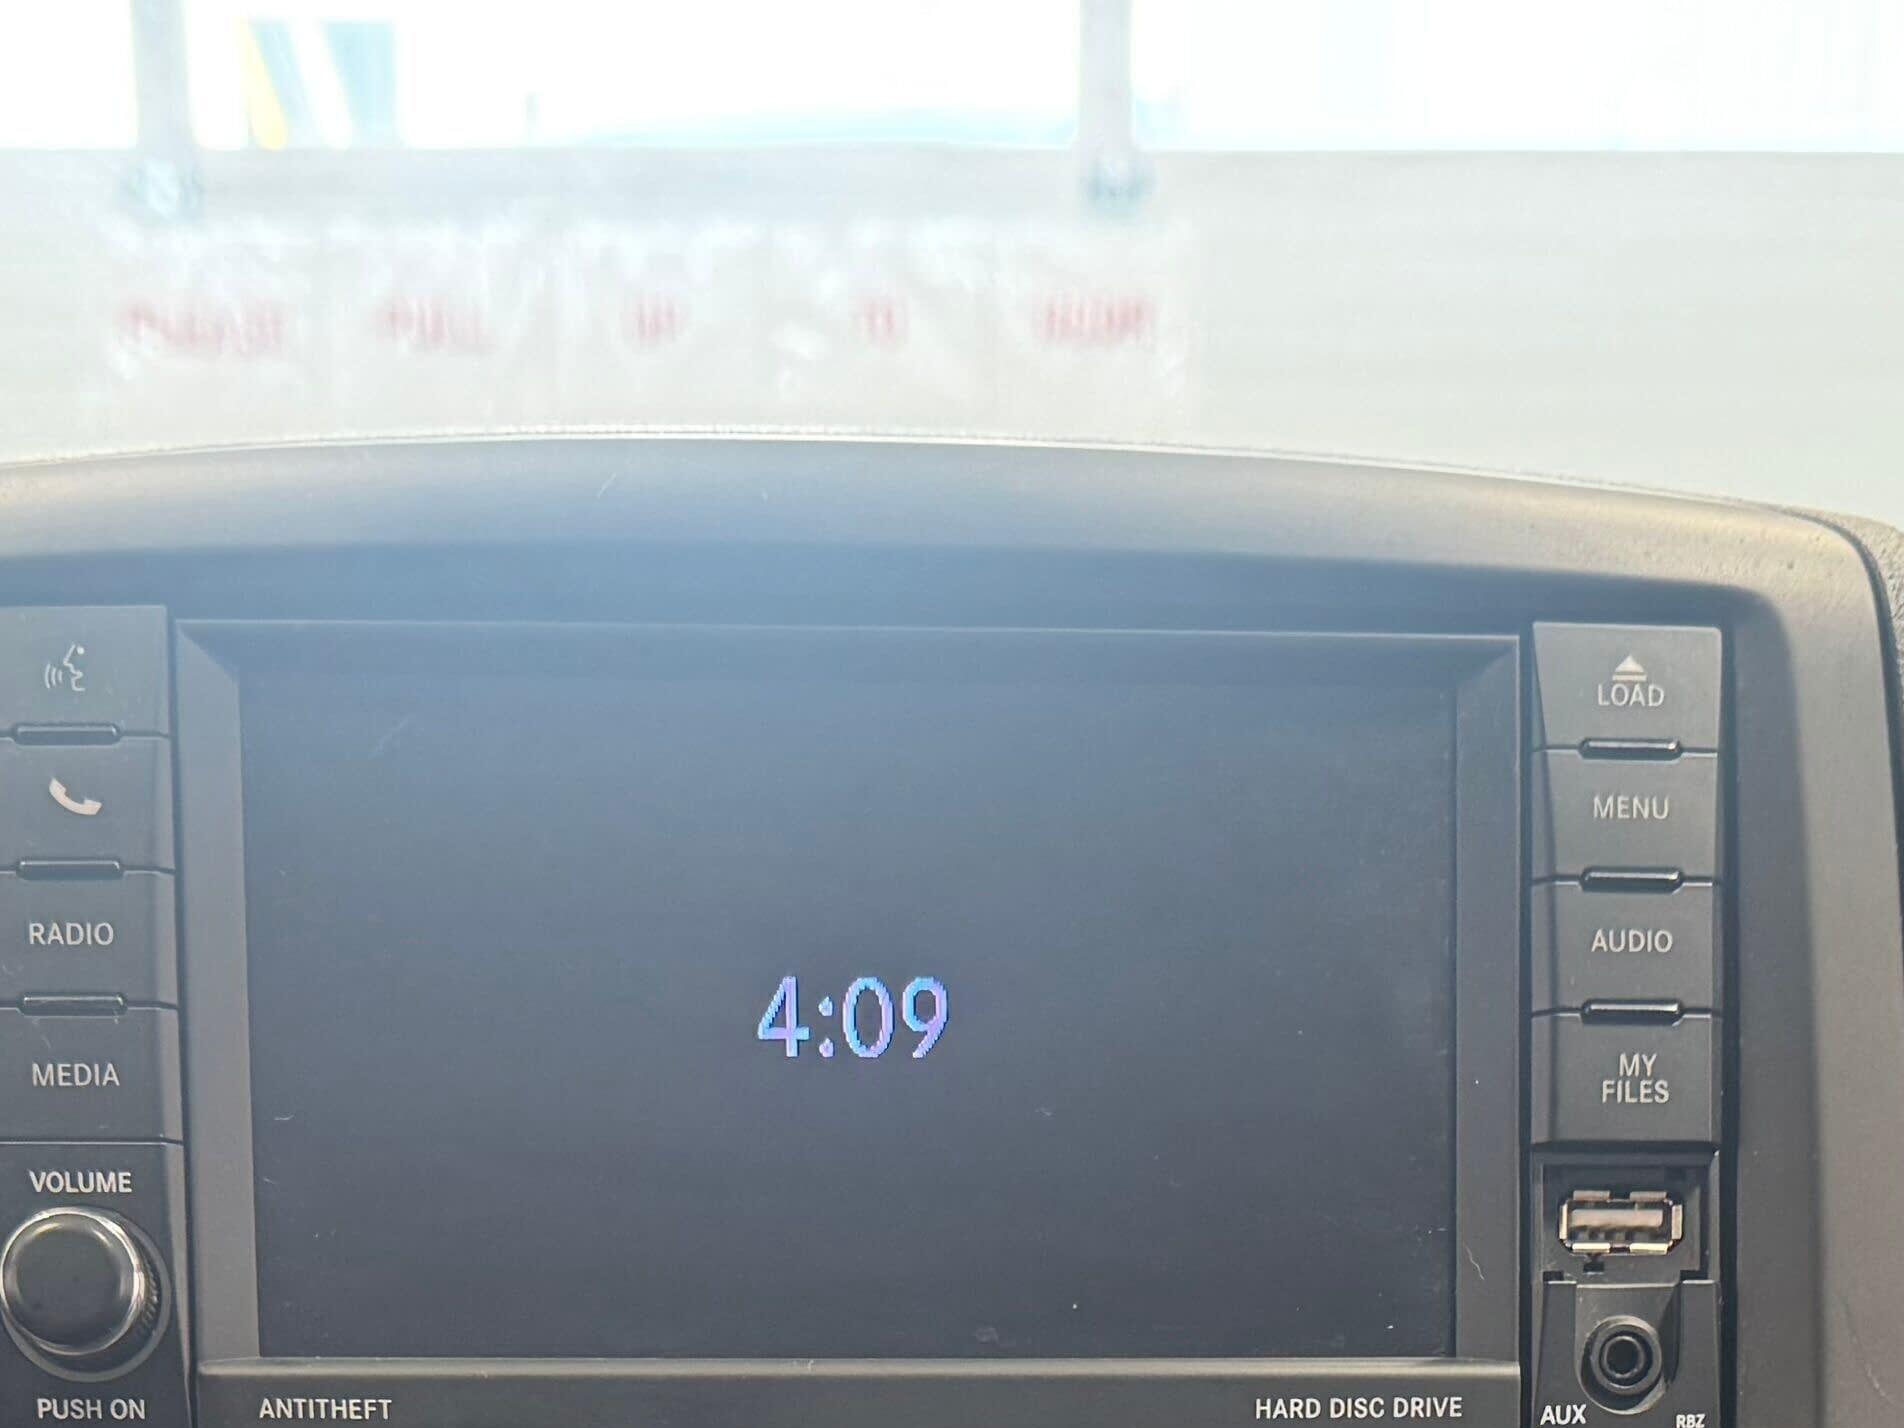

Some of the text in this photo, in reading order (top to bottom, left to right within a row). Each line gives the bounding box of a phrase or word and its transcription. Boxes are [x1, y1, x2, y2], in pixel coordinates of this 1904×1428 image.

[1598, 684, 1664, 706] LOAD
[1594, 796, 1668, 819] MENU
[29, 922, 113, 945] RADIO
[1592, 929, 1673, 952] AUDIO
[757, 976, 946, 1058] 4:09
[32, 1063, 119, 1086] MEDIA
[1620, 1054, 1656, 1076] MY
[1603, 1080, 1669, 1103] FILES
[29, 1171, 132, 1192] VOLUME
[37, 1398, 145, 1419] PUSH ON
[260, 1398, 391, 1419] ANTITHEFT
[1256, 1397, 1461, 1418] HARD DISC DRIVE
[1541, 1404, 1586, 1424] AUX
[1676, 1414, 1705, 1428] RBZ
